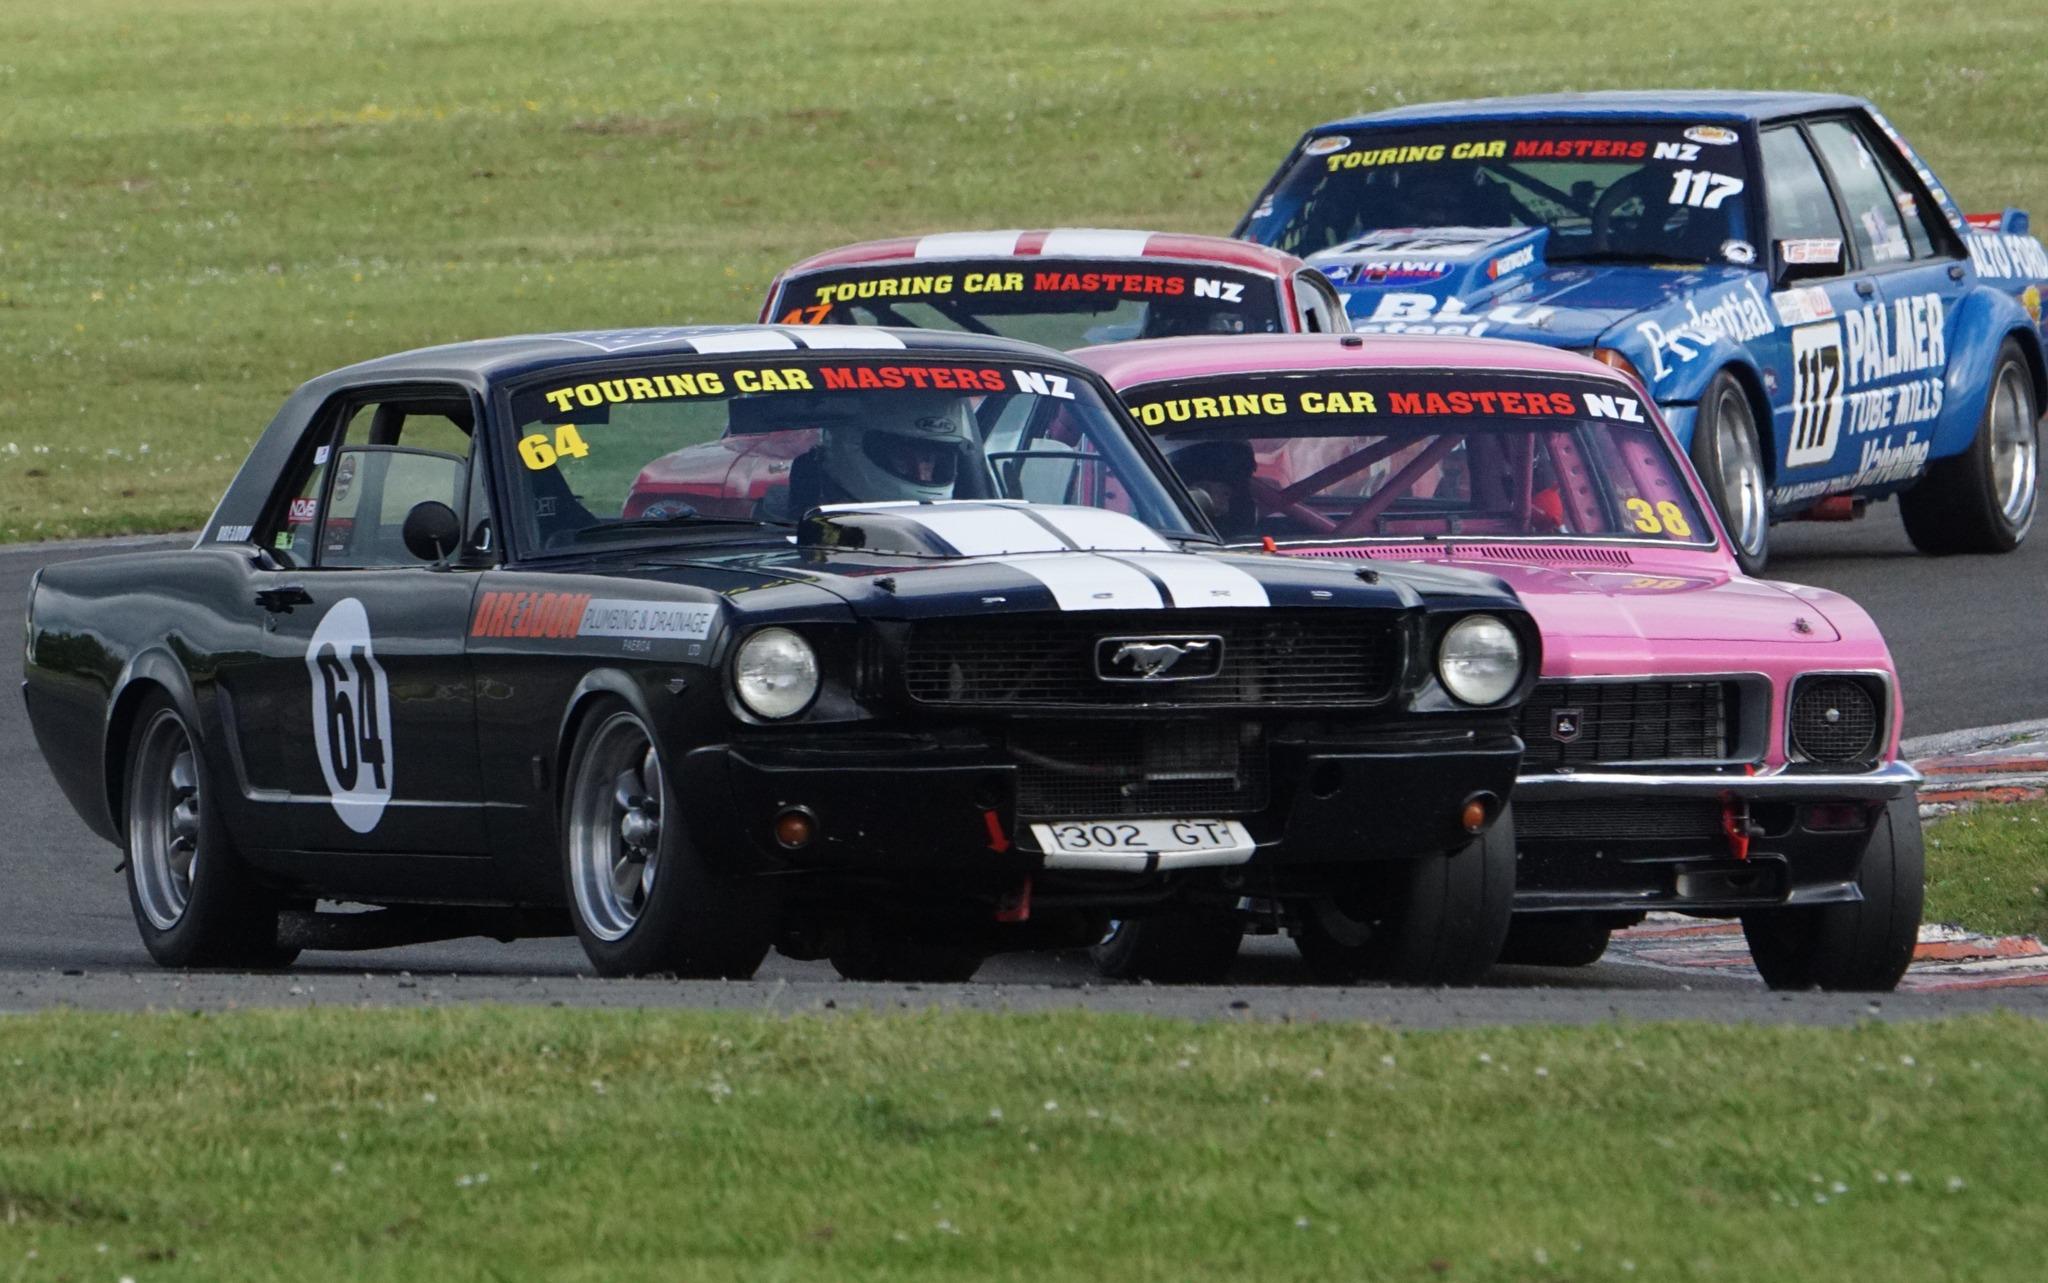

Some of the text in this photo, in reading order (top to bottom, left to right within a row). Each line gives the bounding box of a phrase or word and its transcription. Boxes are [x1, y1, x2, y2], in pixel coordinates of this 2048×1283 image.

[1326, 143, 1445, 172] TOURING
[1451, 140, 1506, 159] CAR
[1513, 140, 1647, 158] MASTERS
[1653, 142, 1701, 161] NZ
[1668, 168, 1744, 209] 117
[815, 273, 1244, 306] TOURING CAR MASTERS NZ
[1636, 280, 1775, 383] Prudential
[1844, 292, 1945, 387] PALMER
[546, 367, 1076, 413] TOURING CAR MASTERS NZ
[1299, 391, 1377, 415] CAR
[1388, 391, 1577, 416] MASTERS
[1582, 395, 1646, 424] NZ
[1796, 345, 1839, 451] 117
[1848, 377, 1944, 435] TUBE MILLS
[517, 423, 590, 471] 64
[1626, 498, 1692, 538] 38
[471, 592, 592, 639] DREADON
[585, 607, 640, 630] PLUMBING
[650, 610, 710, 633] DRAINAGE
[316, 642, 387, 792] 64
[1061, 822, 1222, 849] 302 GT
